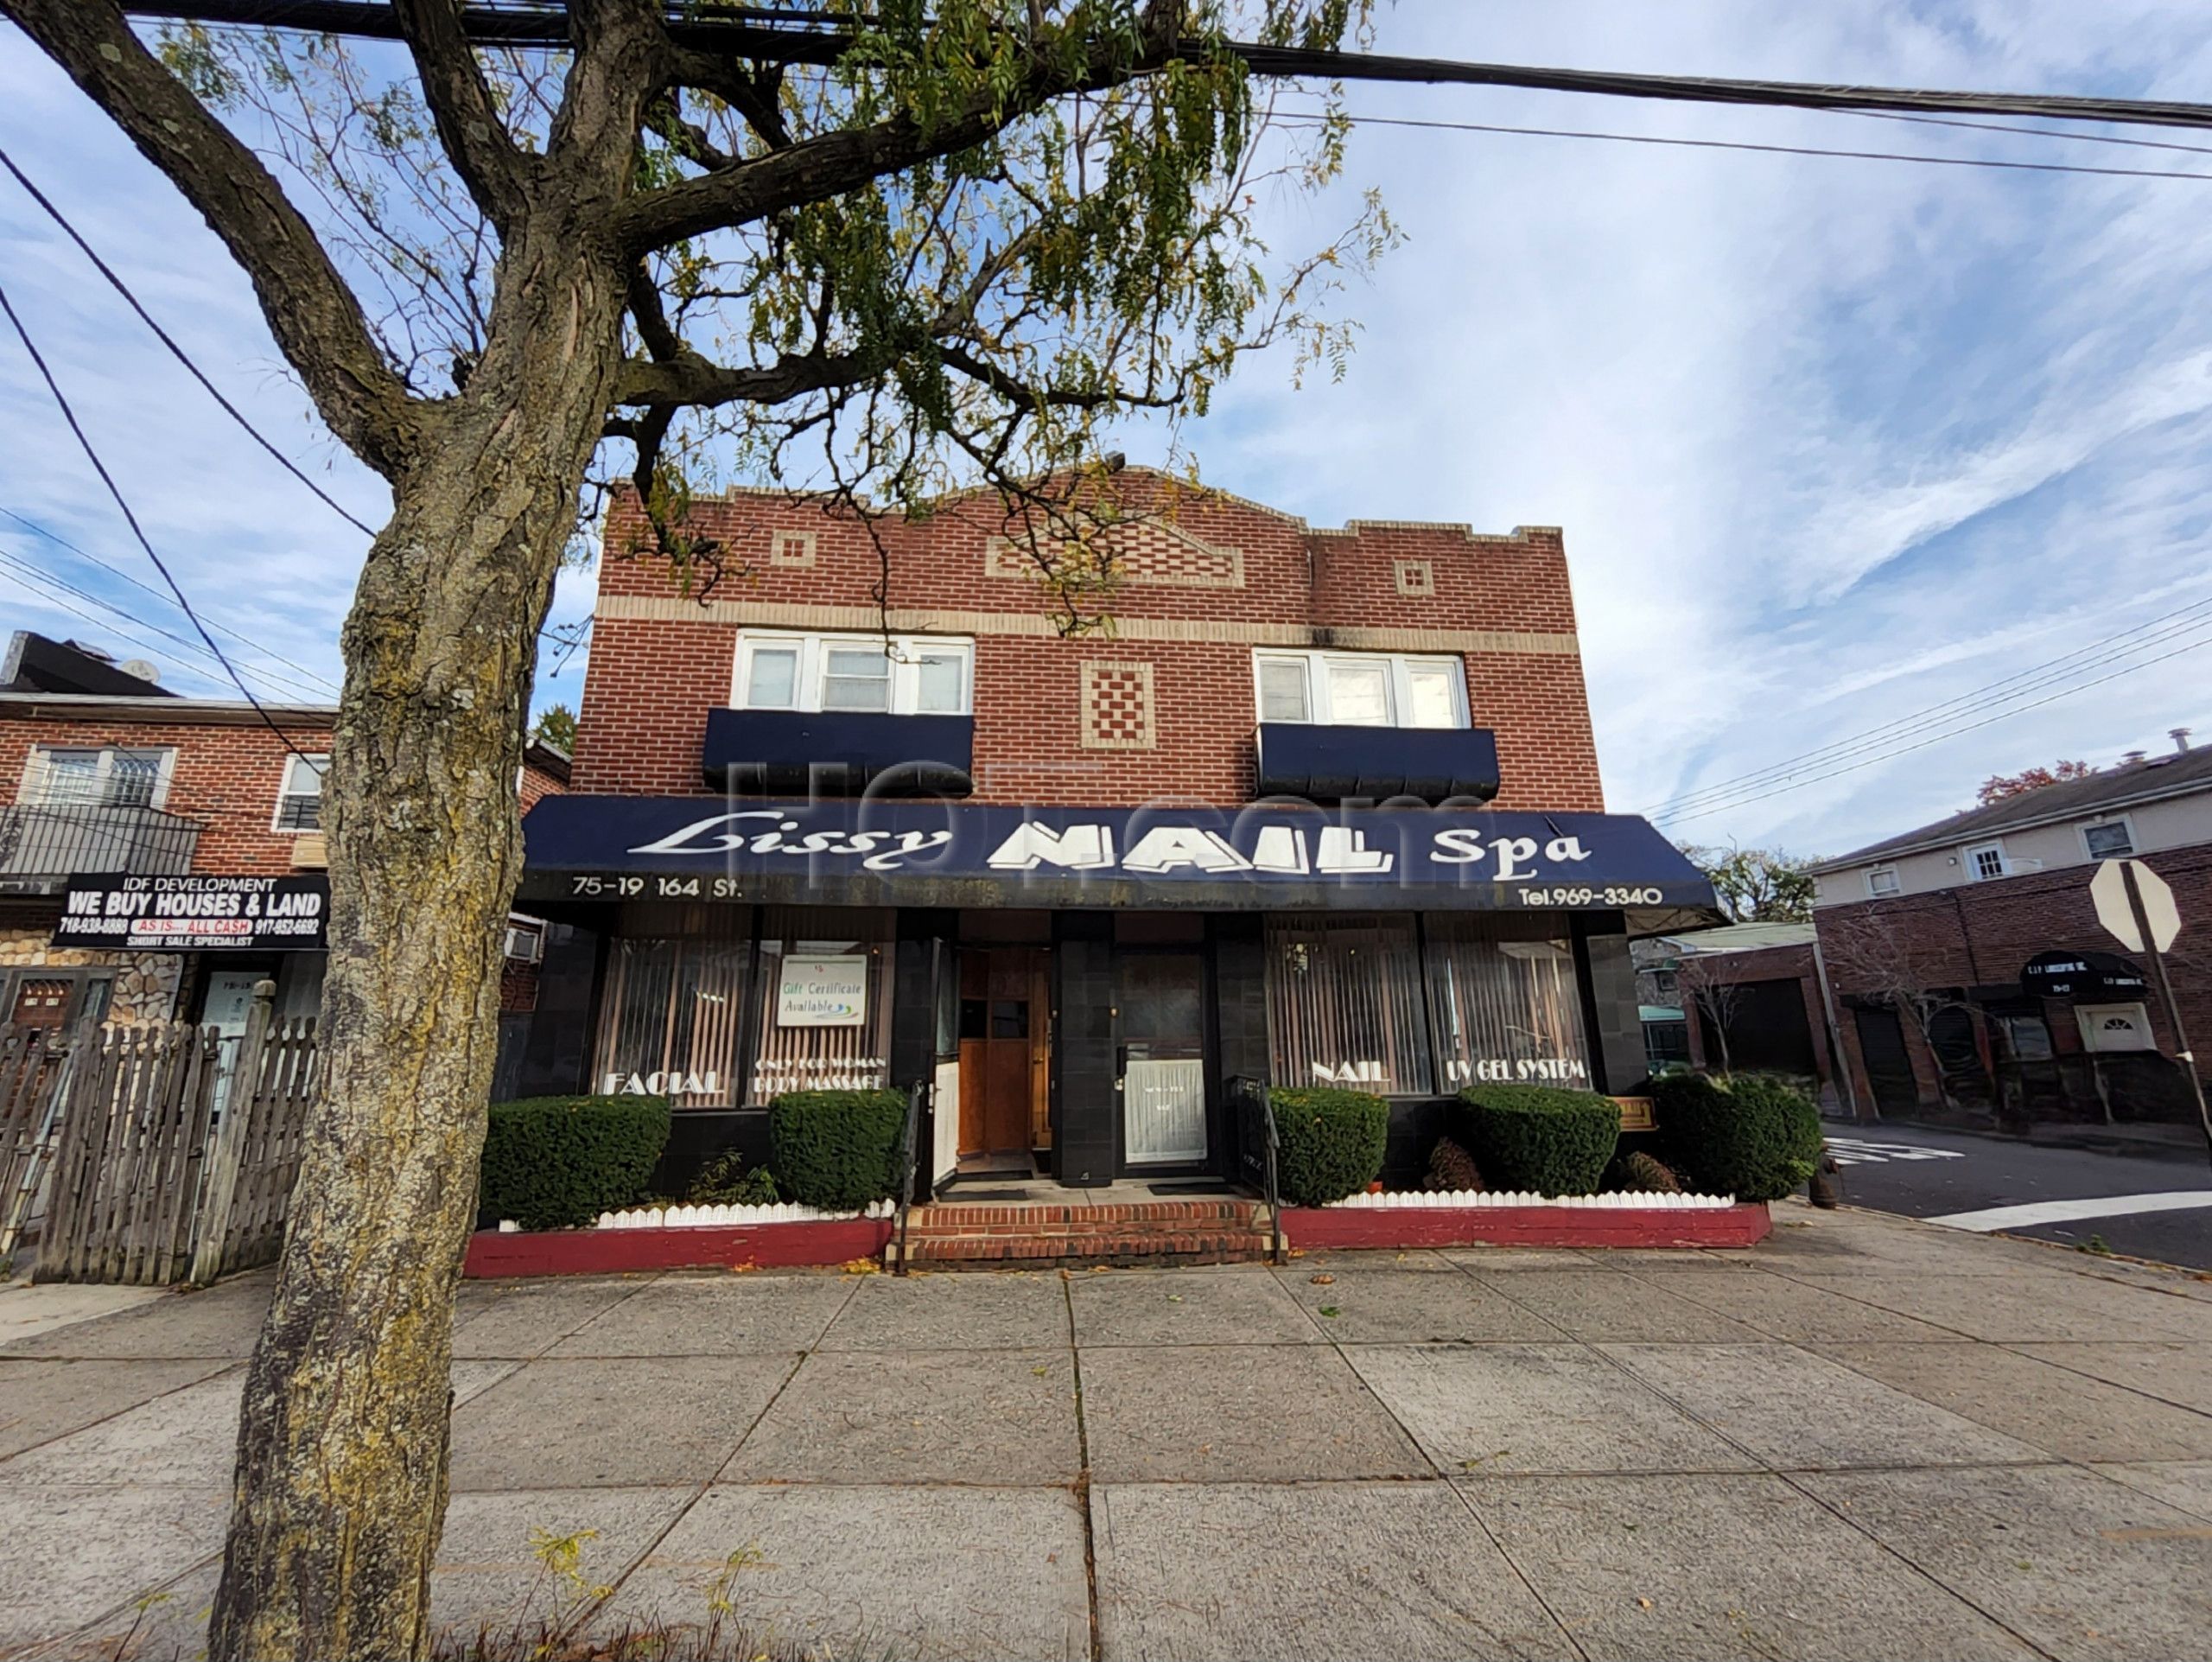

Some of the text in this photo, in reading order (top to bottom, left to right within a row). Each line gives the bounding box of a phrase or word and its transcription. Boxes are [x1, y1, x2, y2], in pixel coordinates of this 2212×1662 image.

[627, 811, 953, 871] Lissy
[1430, 828, 1592, 882] Spa
[123, 877, 277, 892] IDF DEVELOPMENT
[572, 876, 743, 898] 75-19 164 St.
[67, 891, 321, 917] WE BUY HOUSES & LAND
[138, 920, 157, 933] AS
[187, 920, 210, 934] ALL
[126, 936, 254, 946] SHORT SALE SPECIALIST
[783, 982, 861, 995] Gift Certificate
[784, 1000, 833, 1012] Available
[755, 1058, 792, 1070] ONLY
[830, 1057, 887, 1068] WOMAN
[1313, 1060, 1391, 1083] NAIL
[1446, 1059, 1586, 1082] UV GEL SYSTEM
[603, 1072, 725, 1096] FACIAL
[753, 1074, 884, 1093] BODY MASSAGE
